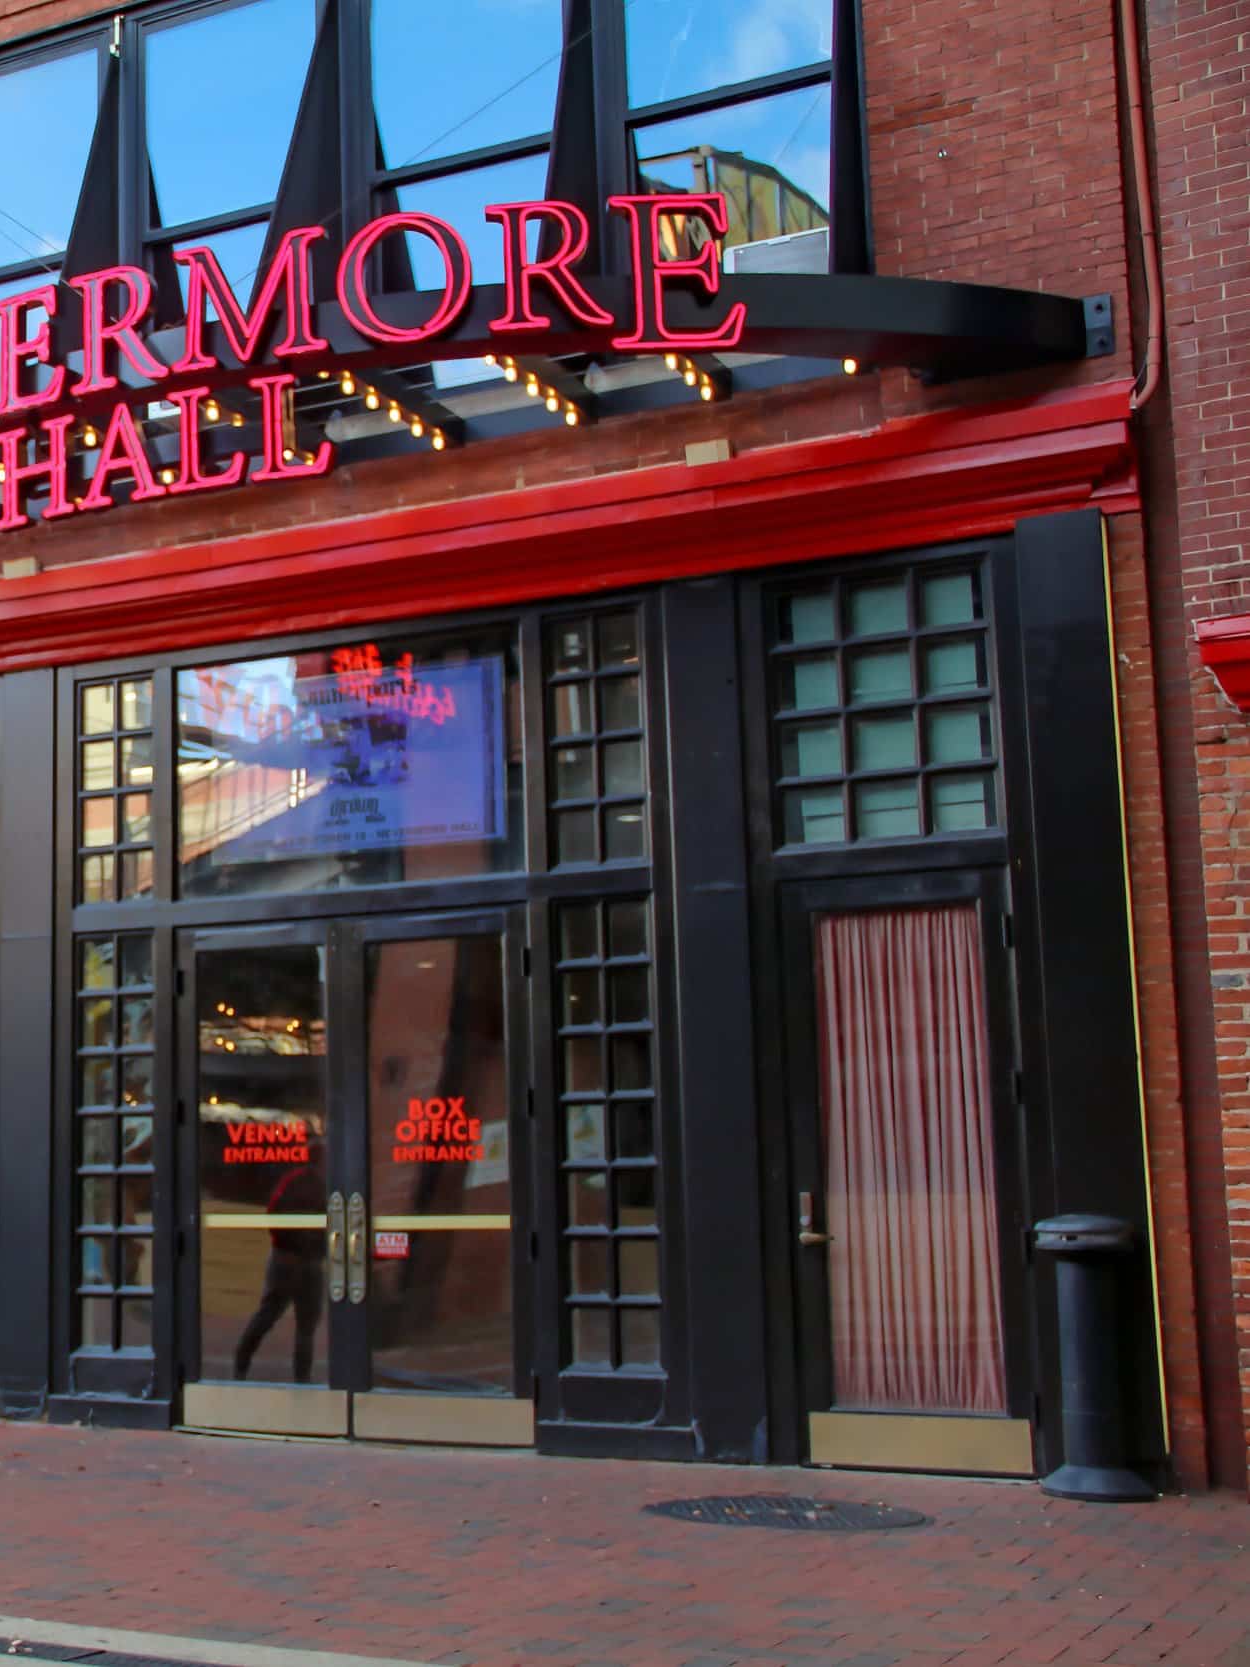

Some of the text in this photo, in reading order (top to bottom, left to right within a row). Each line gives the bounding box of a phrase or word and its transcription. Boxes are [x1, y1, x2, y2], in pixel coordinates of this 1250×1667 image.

[407, 1097, 466, 1121] BOX
[225, 1120, 308, 1145] VENUE
[395, 1119, 483, 1143] OFFICE
[223, 1146, 310, 1164] ENTRANCE
[392, 1144, 486, 1164] ENTRANCE
[378, 1234, 406, 1246] ATM
